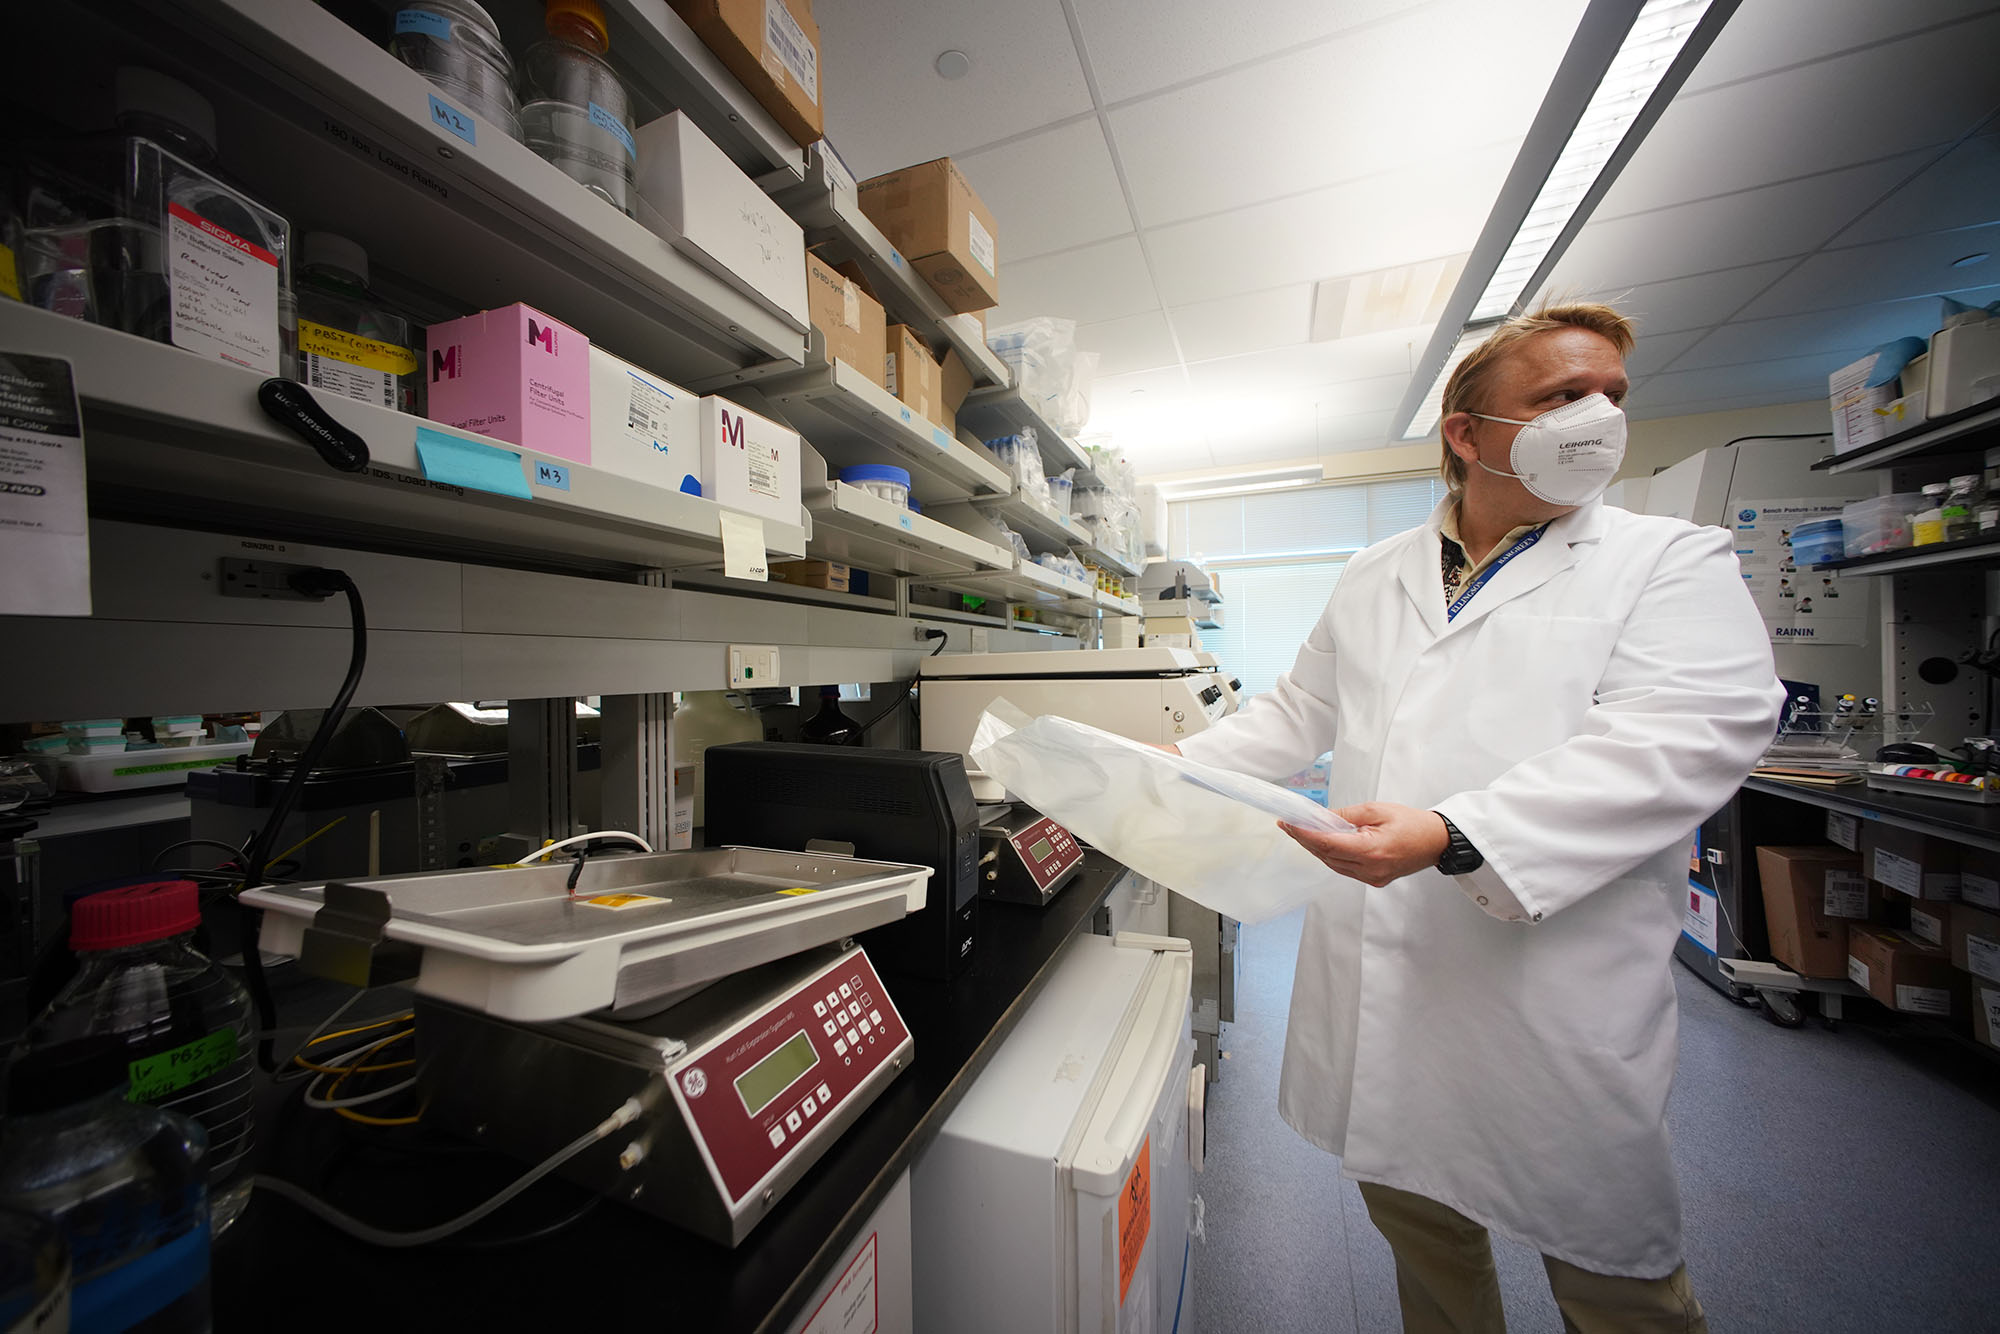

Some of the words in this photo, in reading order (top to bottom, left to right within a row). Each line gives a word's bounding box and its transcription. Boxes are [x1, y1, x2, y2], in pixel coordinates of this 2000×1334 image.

[323, 120, 348, 142] 180
[352, 136, 374, 156] lbs.
[378, 151, 409, 176] Load
[412, 169, 448, 198] Rating
[200, 220, 252, 253] SIGMA
[820, 273, 830, 285] BD
[528, 317, 553, 354] M
[432, 345, 456, 382] M
[529, 378, 565, 399] Centrifugal
[529, 387, 547, 400] Filter
[548, 394, 565, 407] Units
[12, 417, 50, 433] Color
[468, 419, 486, 428] Filter
[488, 414, 506, 425] Units
[1559, 438, 1603, 450] LEIKANG
[398, 473, 427, 488] Load
[540, 467, 561, 484] M3
[0, 483, 44, 495] O-RAD
[1498, 535, 1535, 565] BARGREEN
[1450, 580, 1484, 614] ELLINGSON
[1775, 627, 1815, 637] RAININ
